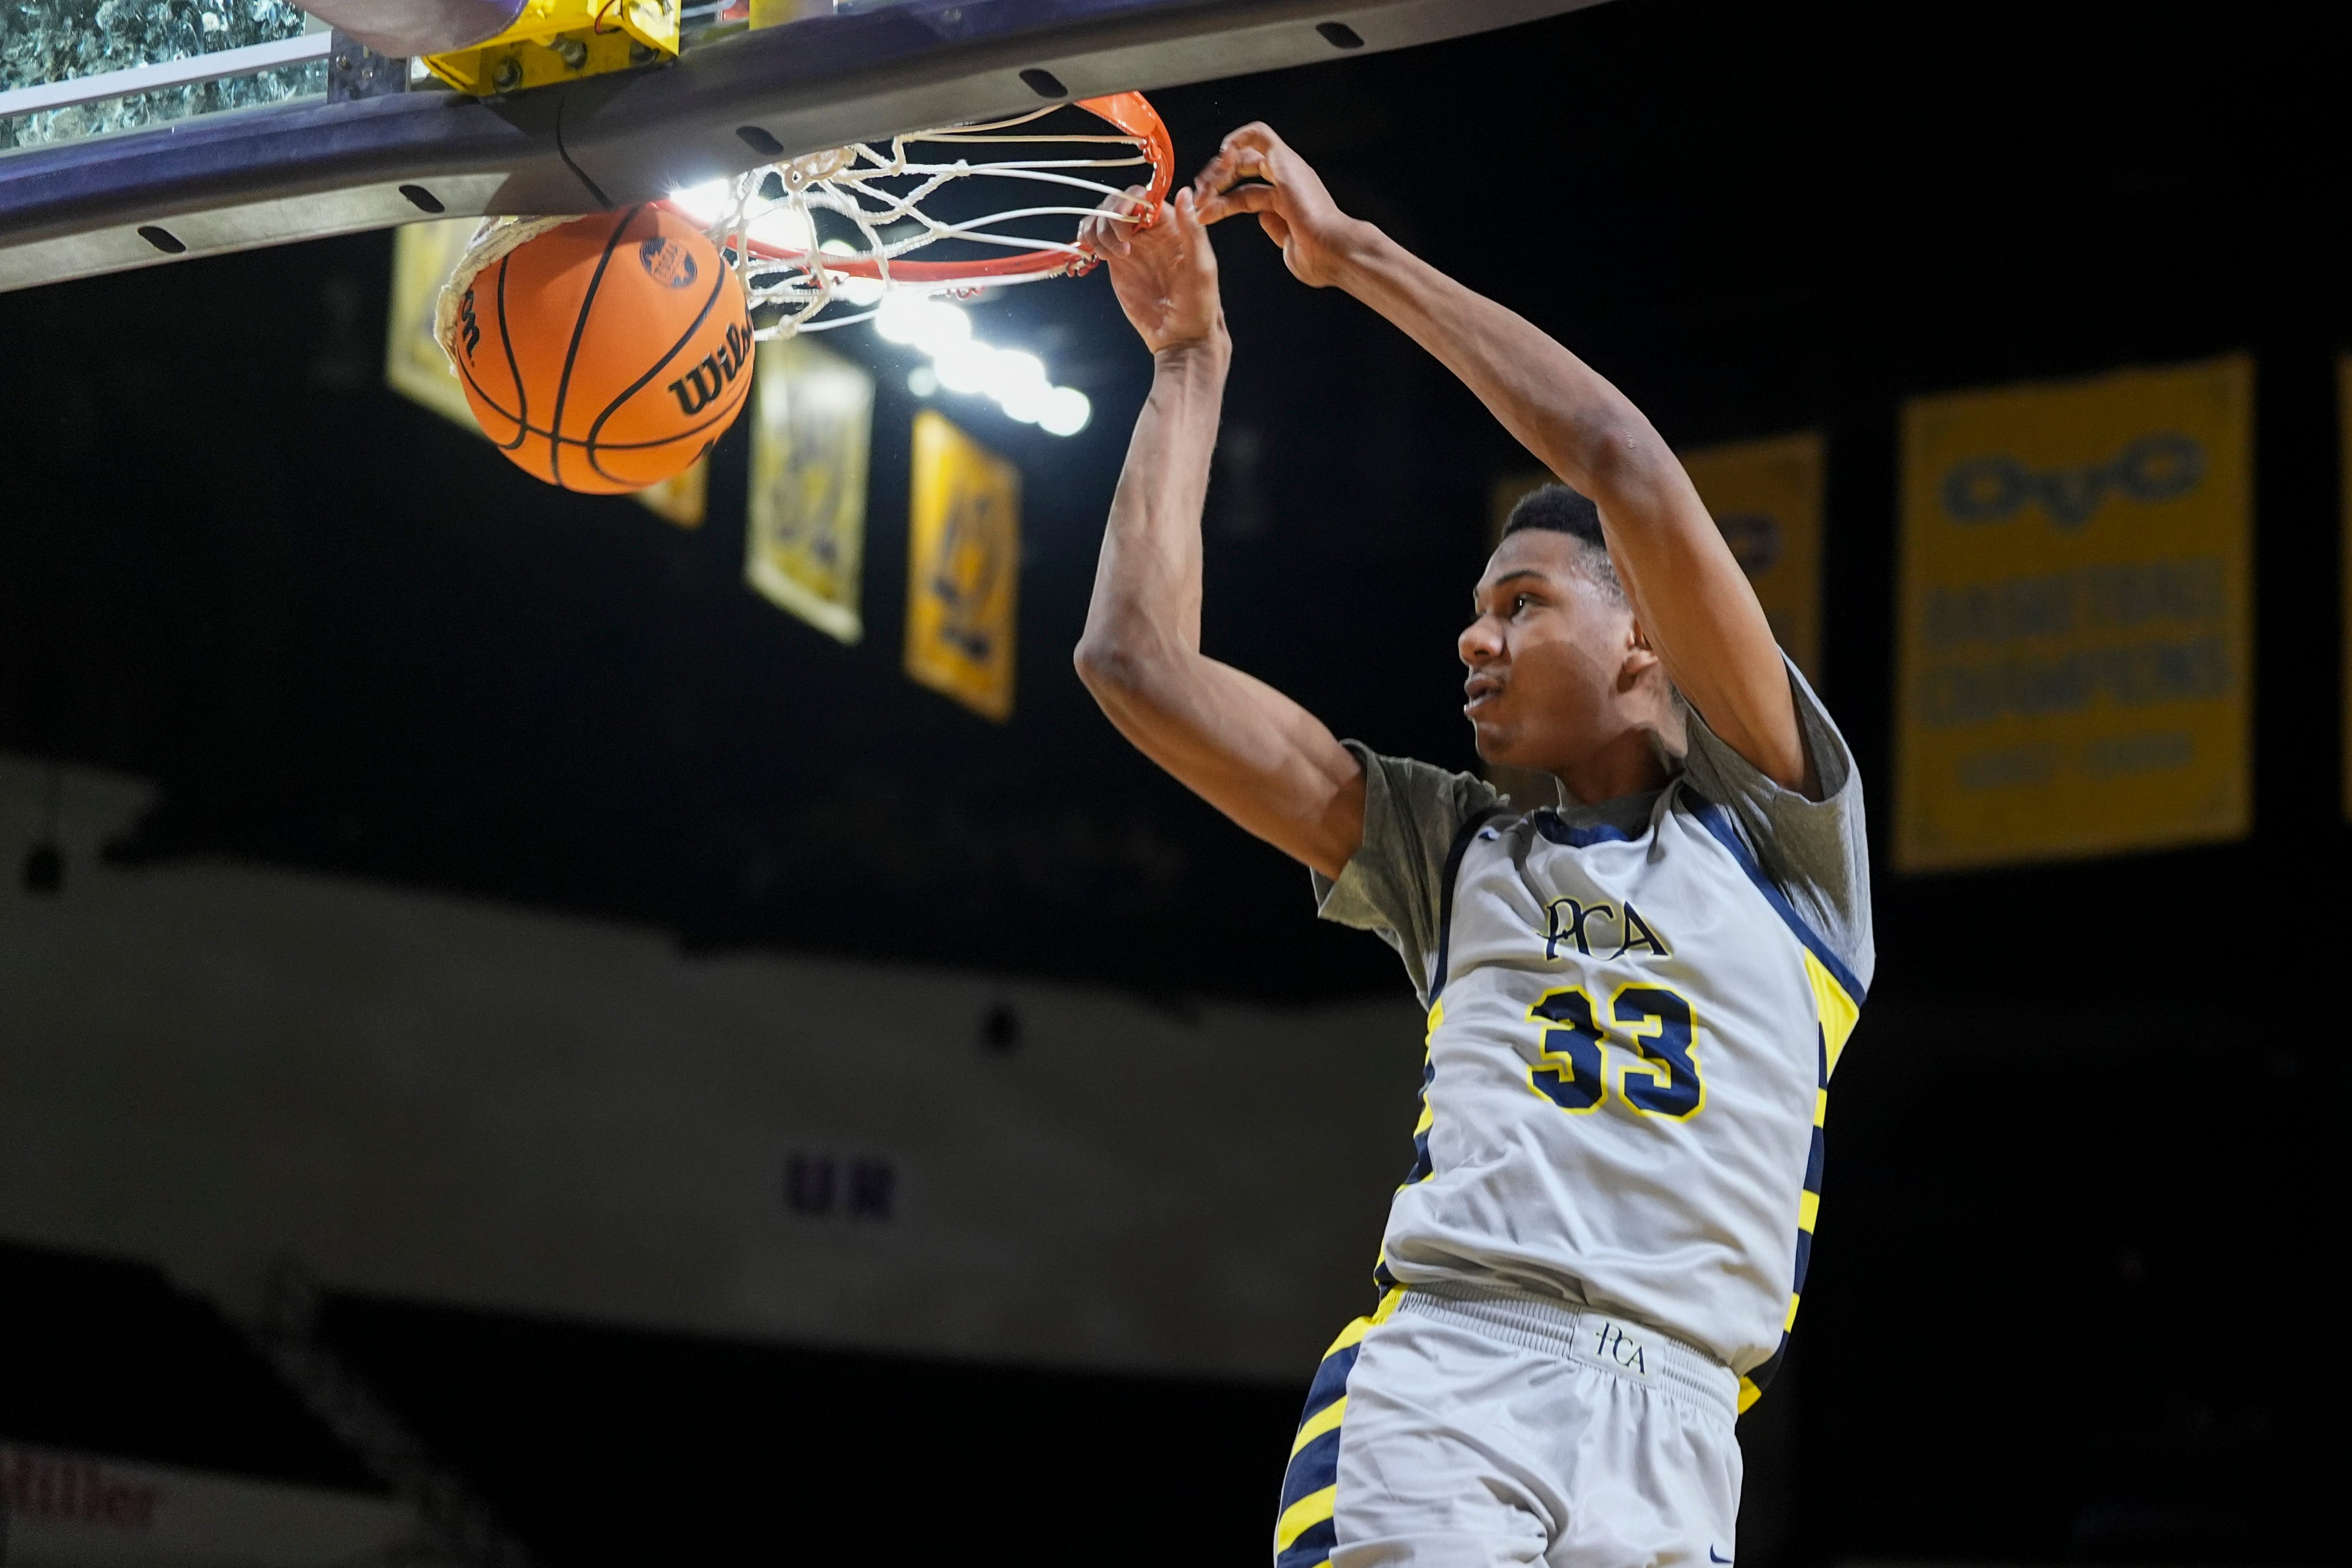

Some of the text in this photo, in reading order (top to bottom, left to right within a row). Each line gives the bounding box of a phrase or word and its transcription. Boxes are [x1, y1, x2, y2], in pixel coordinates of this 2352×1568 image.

[1536, 897, 1670, 961] PCA
[1524, 982, 1706, 1124] 33
[1595, 1321, 1645, 1375] PCA
